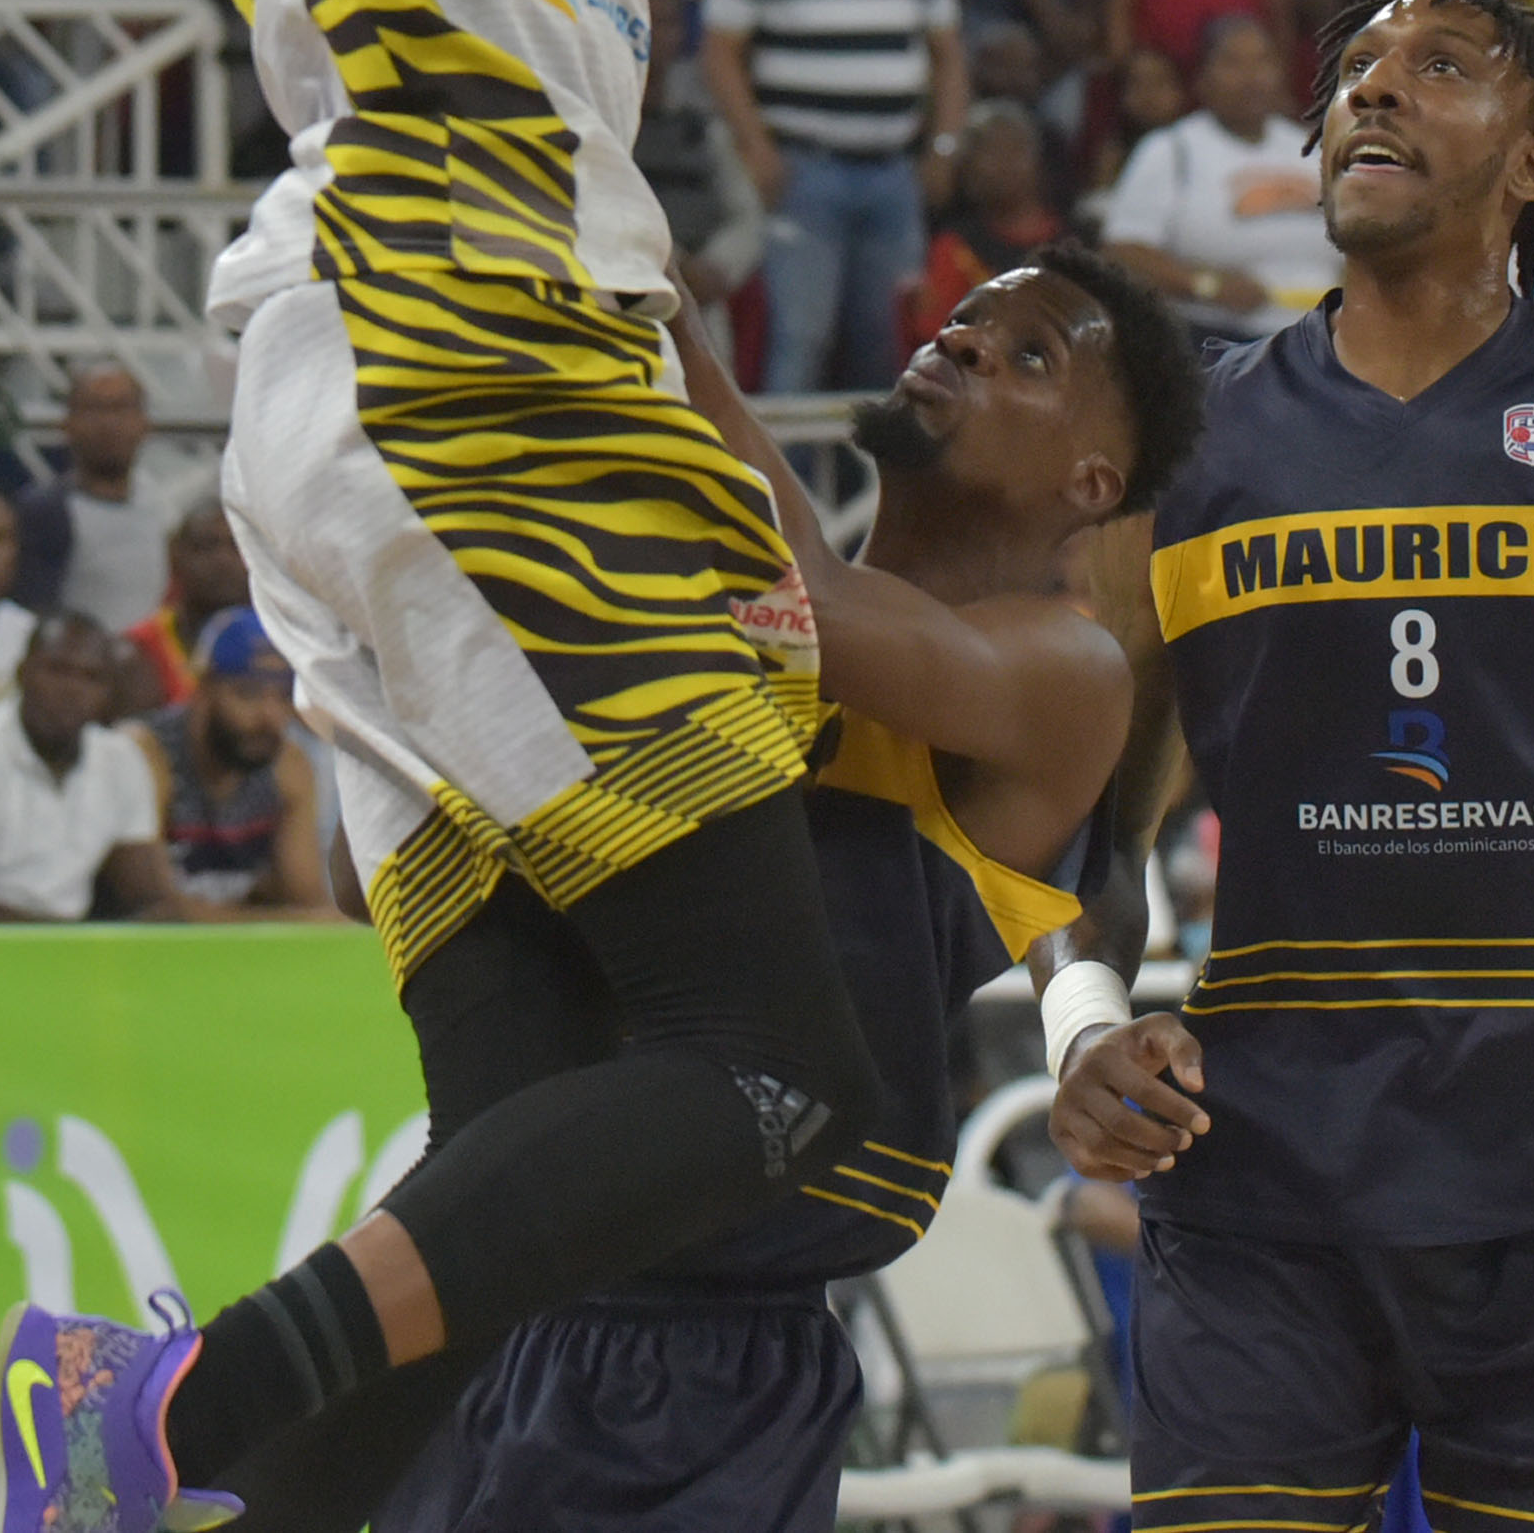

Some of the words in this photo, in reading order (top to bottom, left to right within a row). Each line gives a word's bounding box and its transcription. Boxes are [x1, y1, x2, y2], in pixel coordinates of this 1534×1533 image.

[1390, 609, 1440, 699] 8
[1318, 840, 1330, 854] El
[1334, 840, 1381, 855] banco
[1385, 840, 1404, 854] de
[1407, 839, 1430, 854] los
